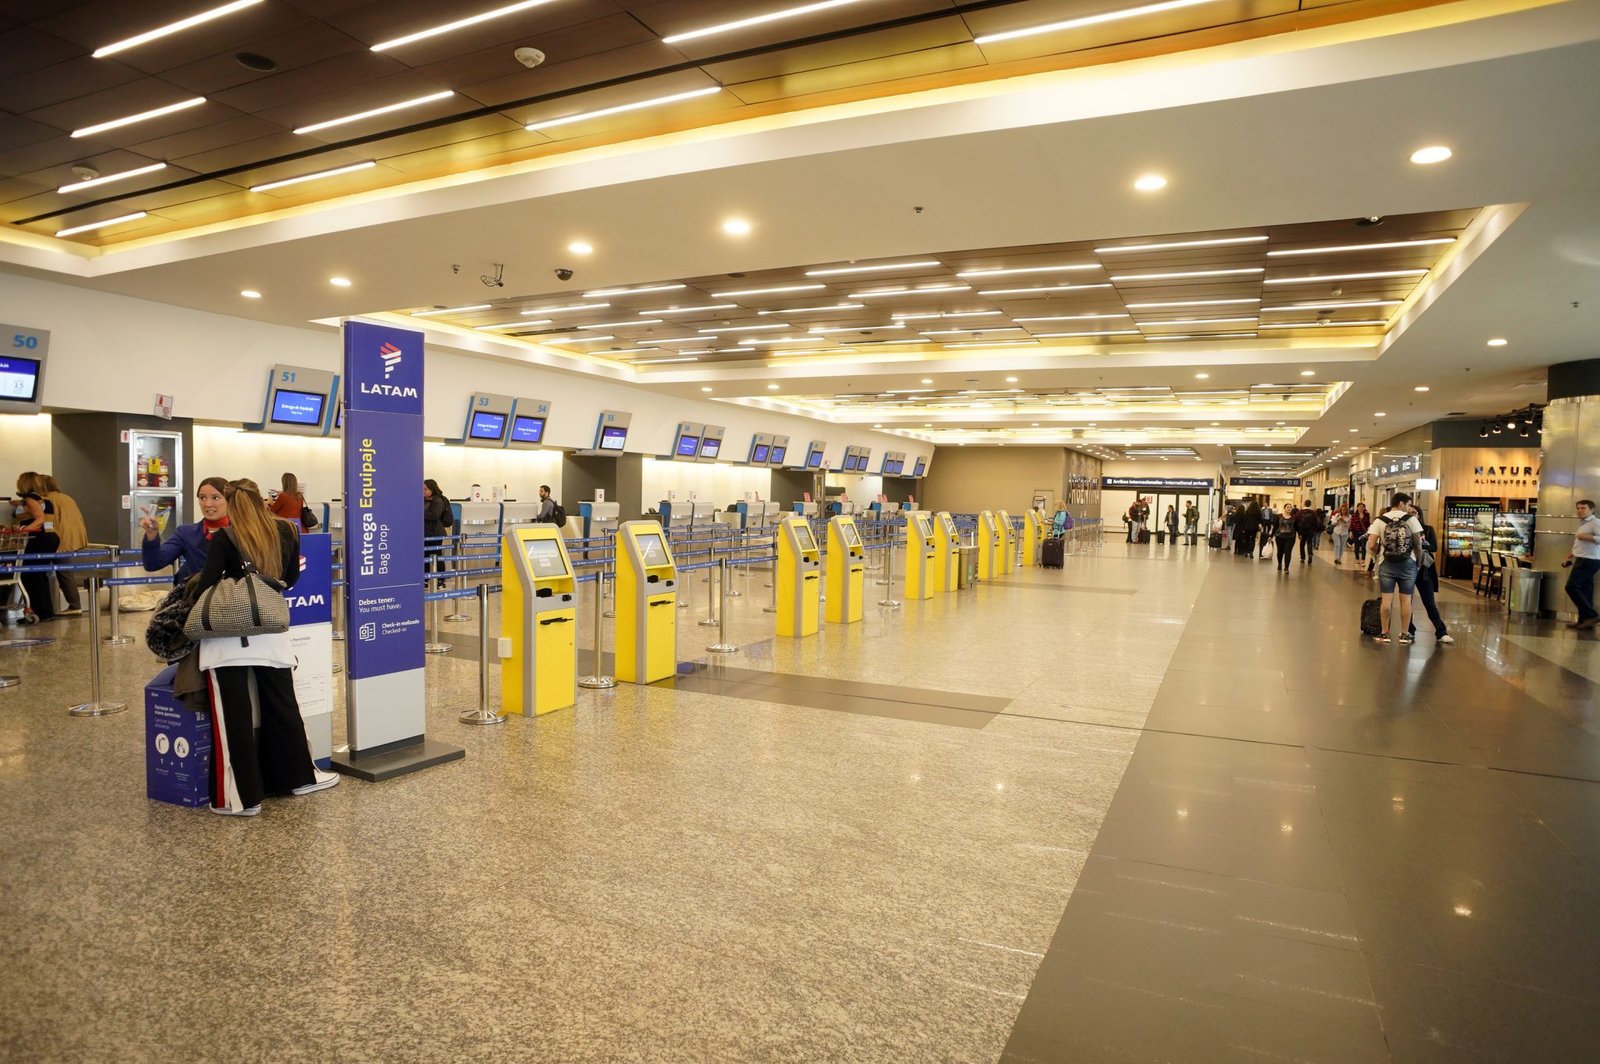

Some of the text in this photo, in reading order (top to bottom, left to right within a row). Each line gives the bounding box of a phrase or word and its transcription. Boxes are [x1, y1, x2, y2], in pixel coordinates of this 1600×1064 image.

[13, 334, 38, 349] 50
[281, 371, 296, 382] 51
[360, 382, 418, 398] LATAM
[479, 397, 489, 406] 53
[537, 404, 547, 412] 54
[359, 438, 377, 576] Entrega Equipaje
[378, 524, 390, 574] Bag Drop
[285, 594, 325, 608] TAM
[359, 598, 377, 606] Debes
